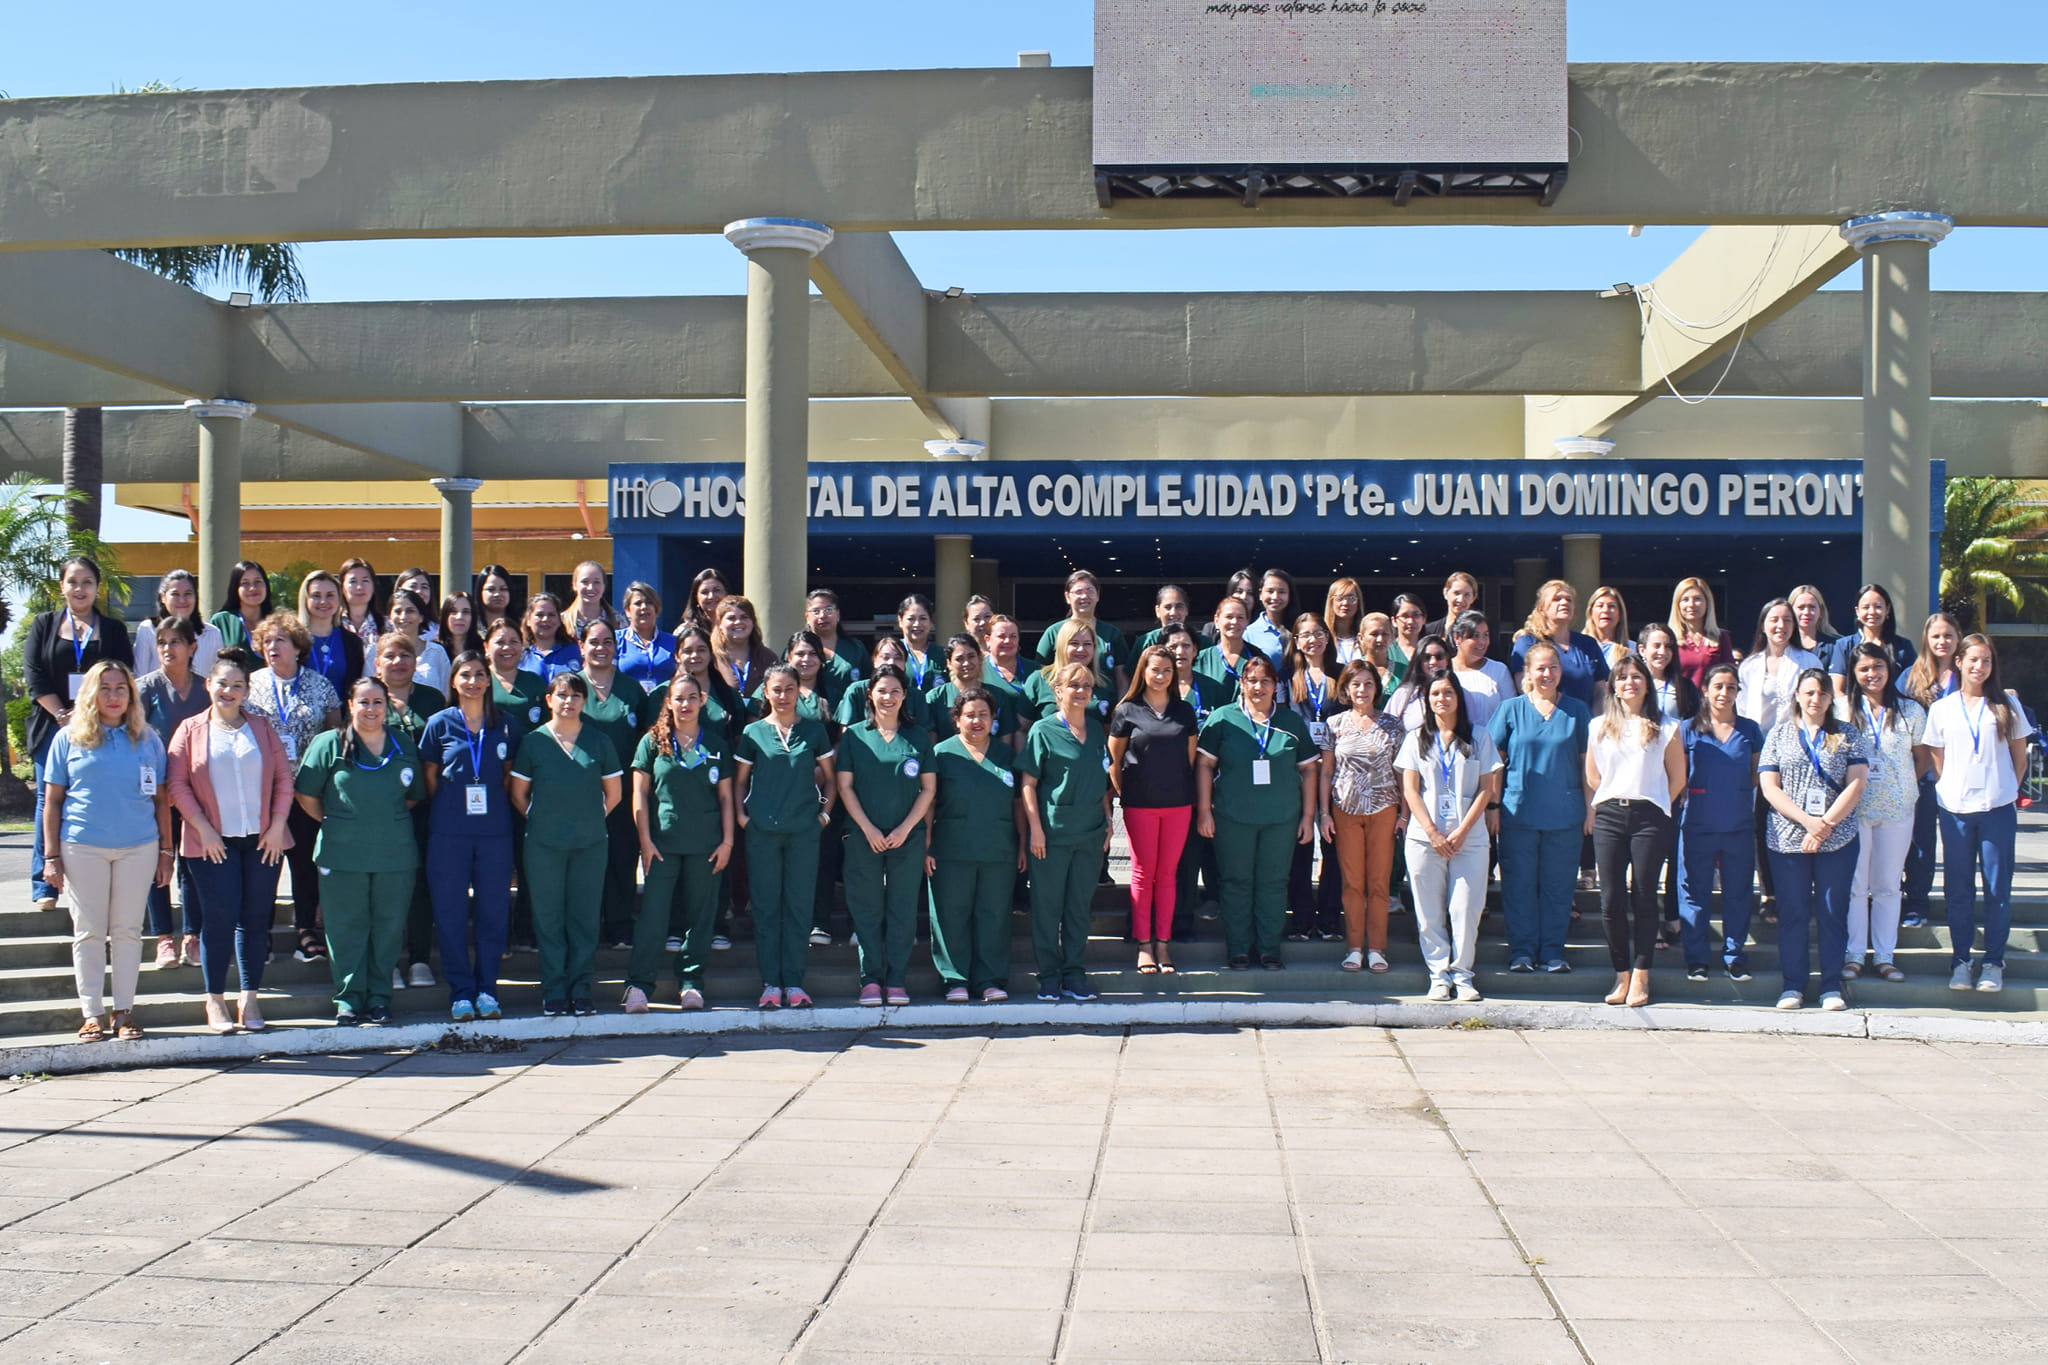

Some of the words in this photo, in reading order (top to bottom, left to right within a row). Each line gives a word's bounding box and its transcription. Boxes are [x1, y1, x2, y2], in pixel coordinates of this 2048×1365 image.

[683, 476, 865, 518] HOAL
[871, 475, 921, 517] DE
[928, 475, 1023, 517] ALTA
[1027, 474, 1297, 517] COMPLEJIDAD
[1402, 473, 1509, 516] JUAN
[1519, 472, 1709, 516] DOMINGO
